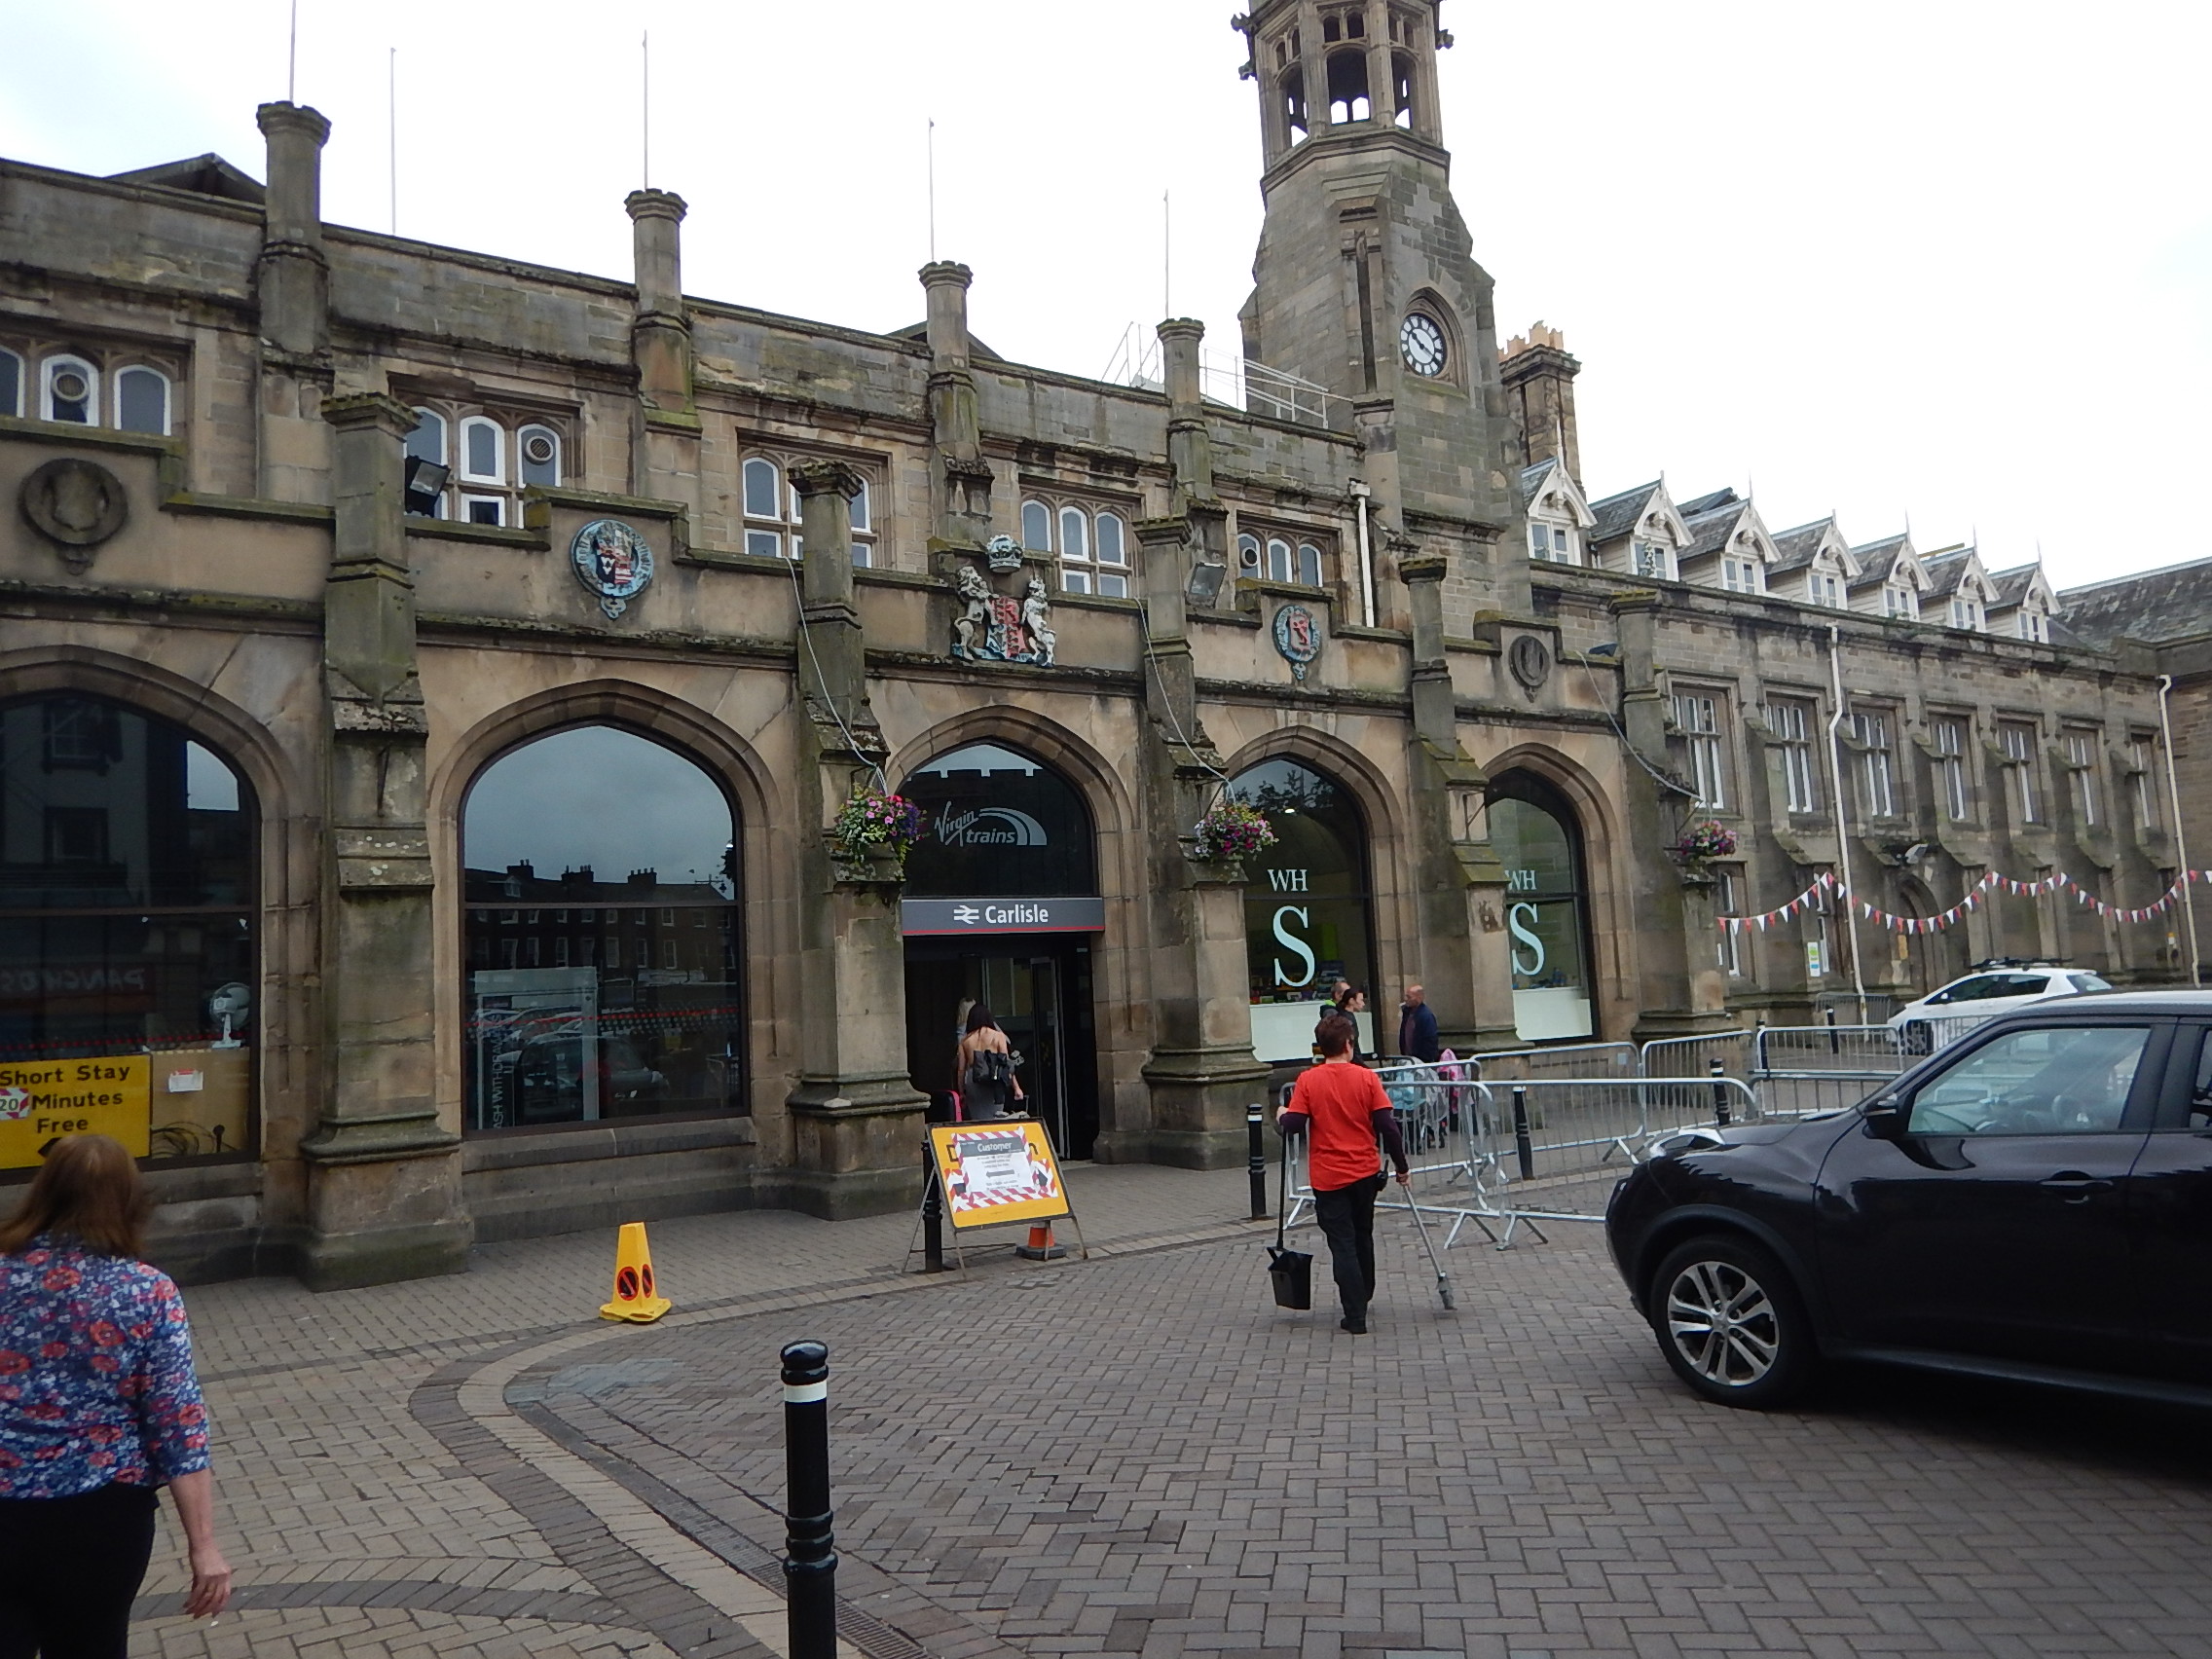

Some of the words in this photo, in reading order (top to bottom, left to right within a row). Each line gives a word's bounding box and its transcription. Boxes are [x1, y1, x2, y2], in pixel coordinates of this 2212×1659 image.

[935, 801, 979, 847] Virgin
[966, 829, 1015, 844] trains
[1268, 869, 1309, 892] WH
[1505, 869, 1536, 891] WH
[985, 904, 1050, 923] Carlisle
[1272, 905, 1315, 987] S
[1510, 903, 1545, 976] S
[0, 1068, 64, 1086] Short
[77, 1065, 130, 1081] Stay
[32, 1091, 123, 1110] Minutes
[37, 1118, 89, 1133] Free
[977, 1142, 1012, 1153] Customer
